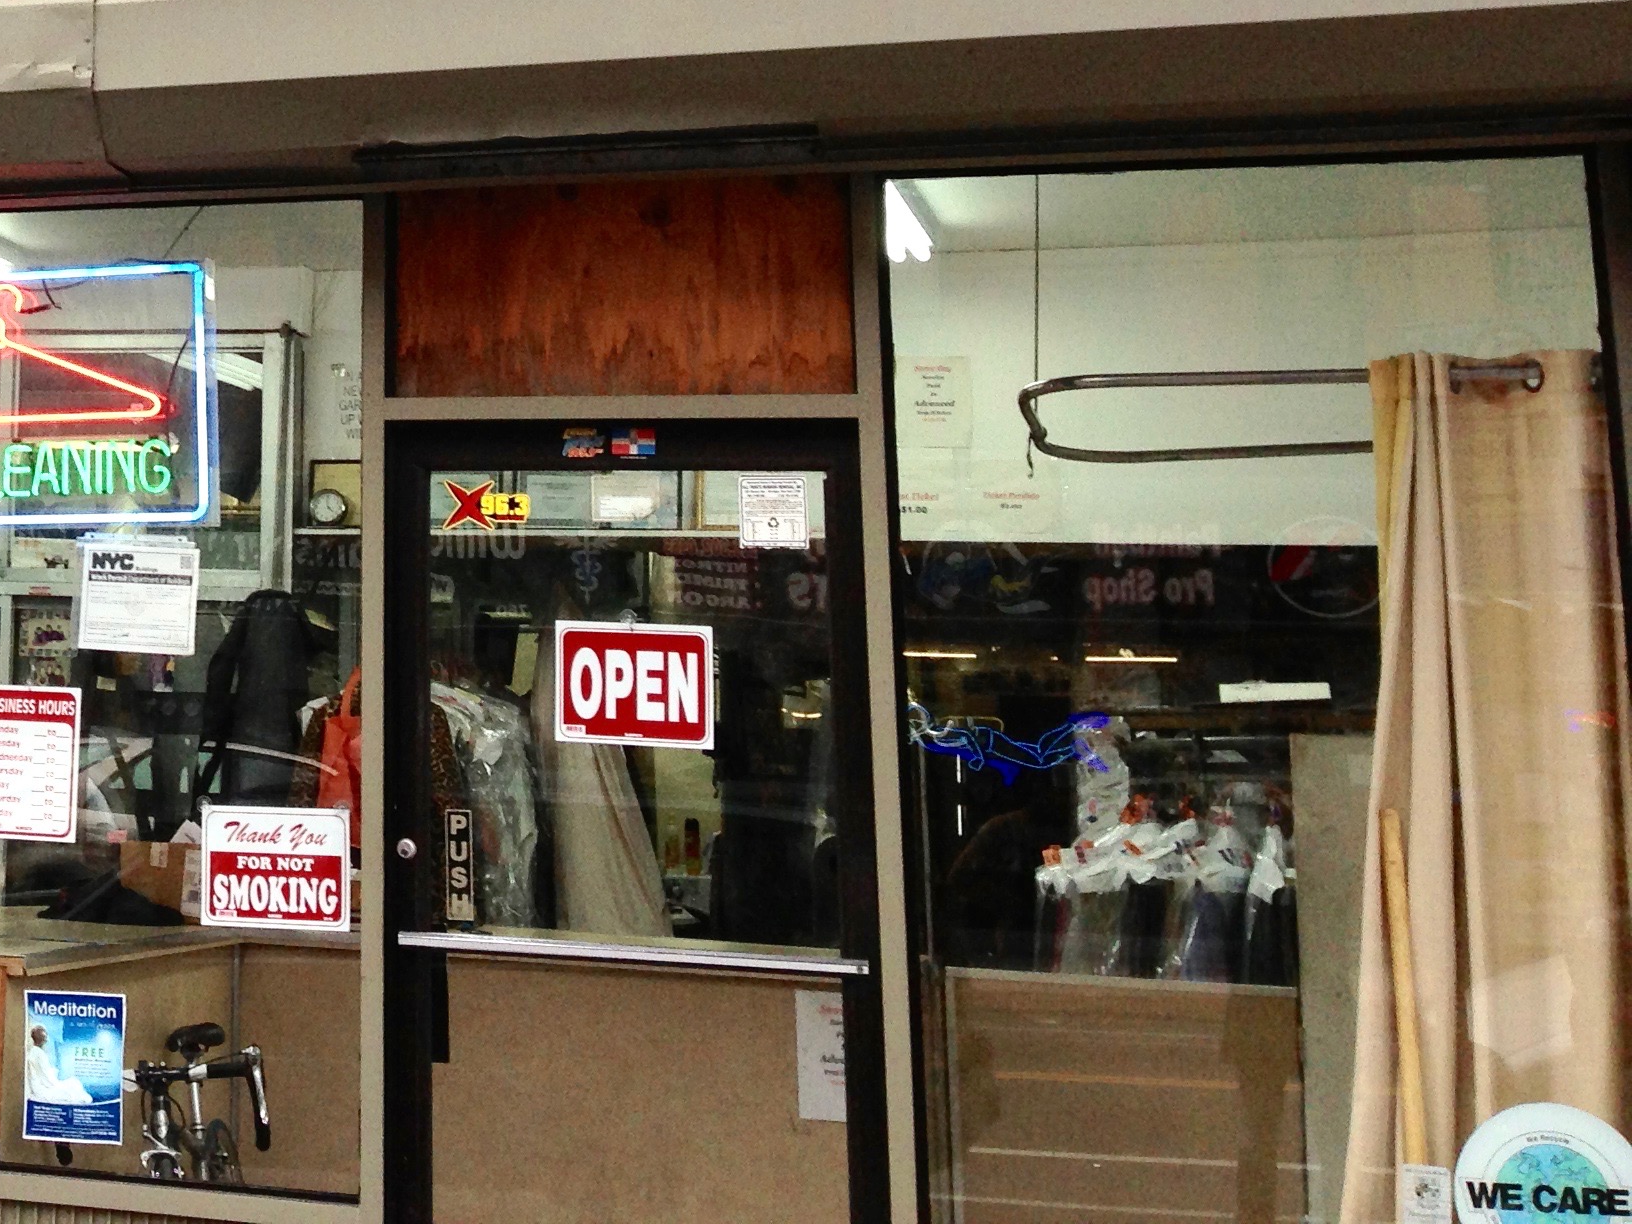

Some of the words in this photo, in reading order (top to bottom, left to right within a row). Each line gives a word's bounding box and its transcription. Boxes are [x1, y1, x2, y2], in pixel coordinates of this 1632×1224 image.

[91, 552, 135, 571] NYC
[570, 646, 699, 724] OPEN
[38, 700, 76, 716] HOURS
[223, 820, 284, 845] Thank
[289, 823, 328, 851] You
[236, 855, 273, 871] FOR
[276, 856, 315, 872] NOT
[449, 814, 469, 918] PUSH
[212, 873, 339, 915] SMOKING
[33, 1000, 117, 1019] Meditation
[1465, 1180, 1524, 1211] WE
[1532, 1184, 1632, 1217] CARE
